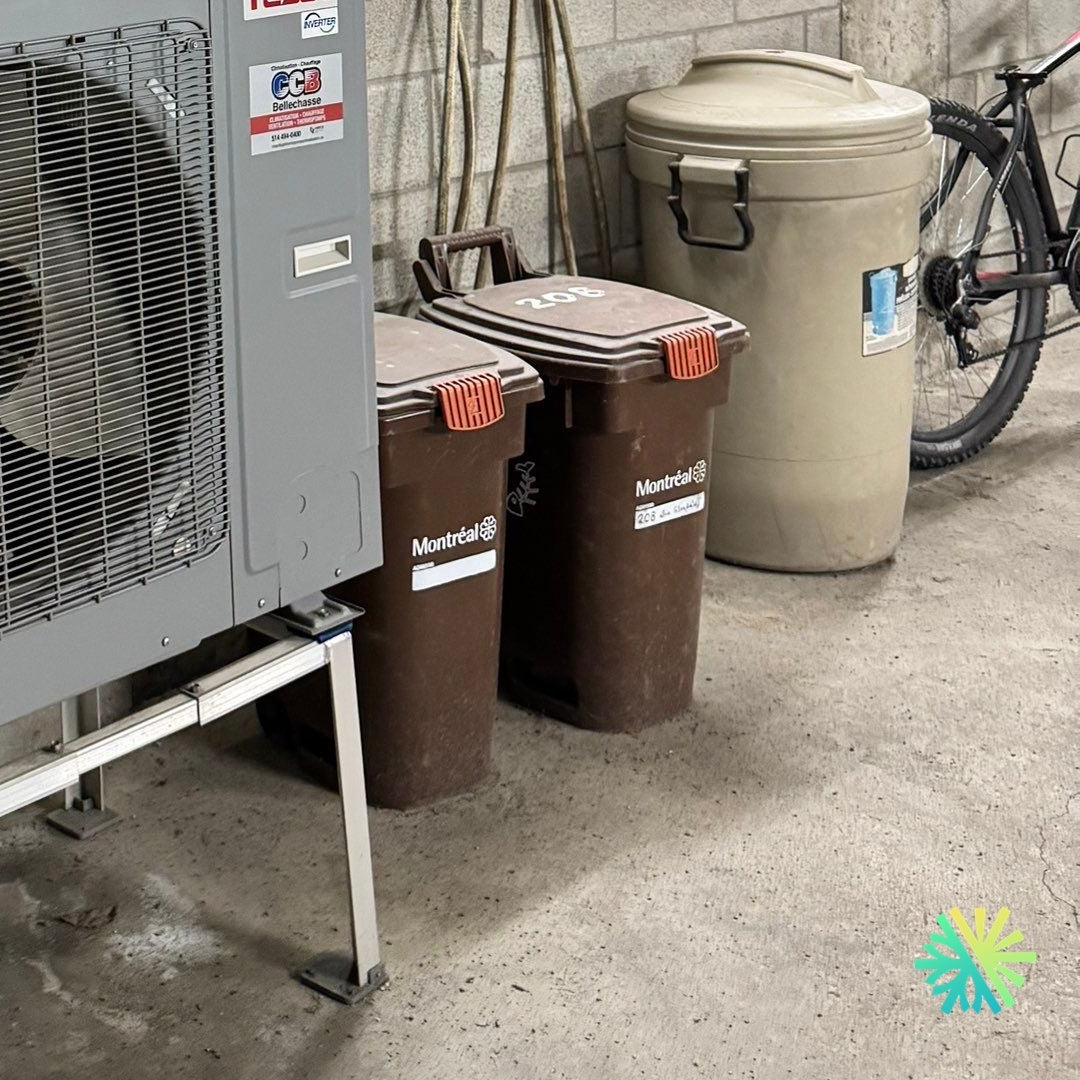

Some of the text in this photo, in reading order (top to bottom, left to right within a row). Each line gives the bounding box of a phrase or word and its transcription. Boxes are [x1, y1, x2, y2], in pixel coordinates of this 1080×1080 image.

[304, 17, 336, 29] INVERTER
[271, 67, 322, 100] CCB
[273, 97, 322, 112] Bellechasse
[515, 287, 606, 309] 208
[635, 466, 692, 498] Montréal
[412, 522, 479, 557] Montréal
